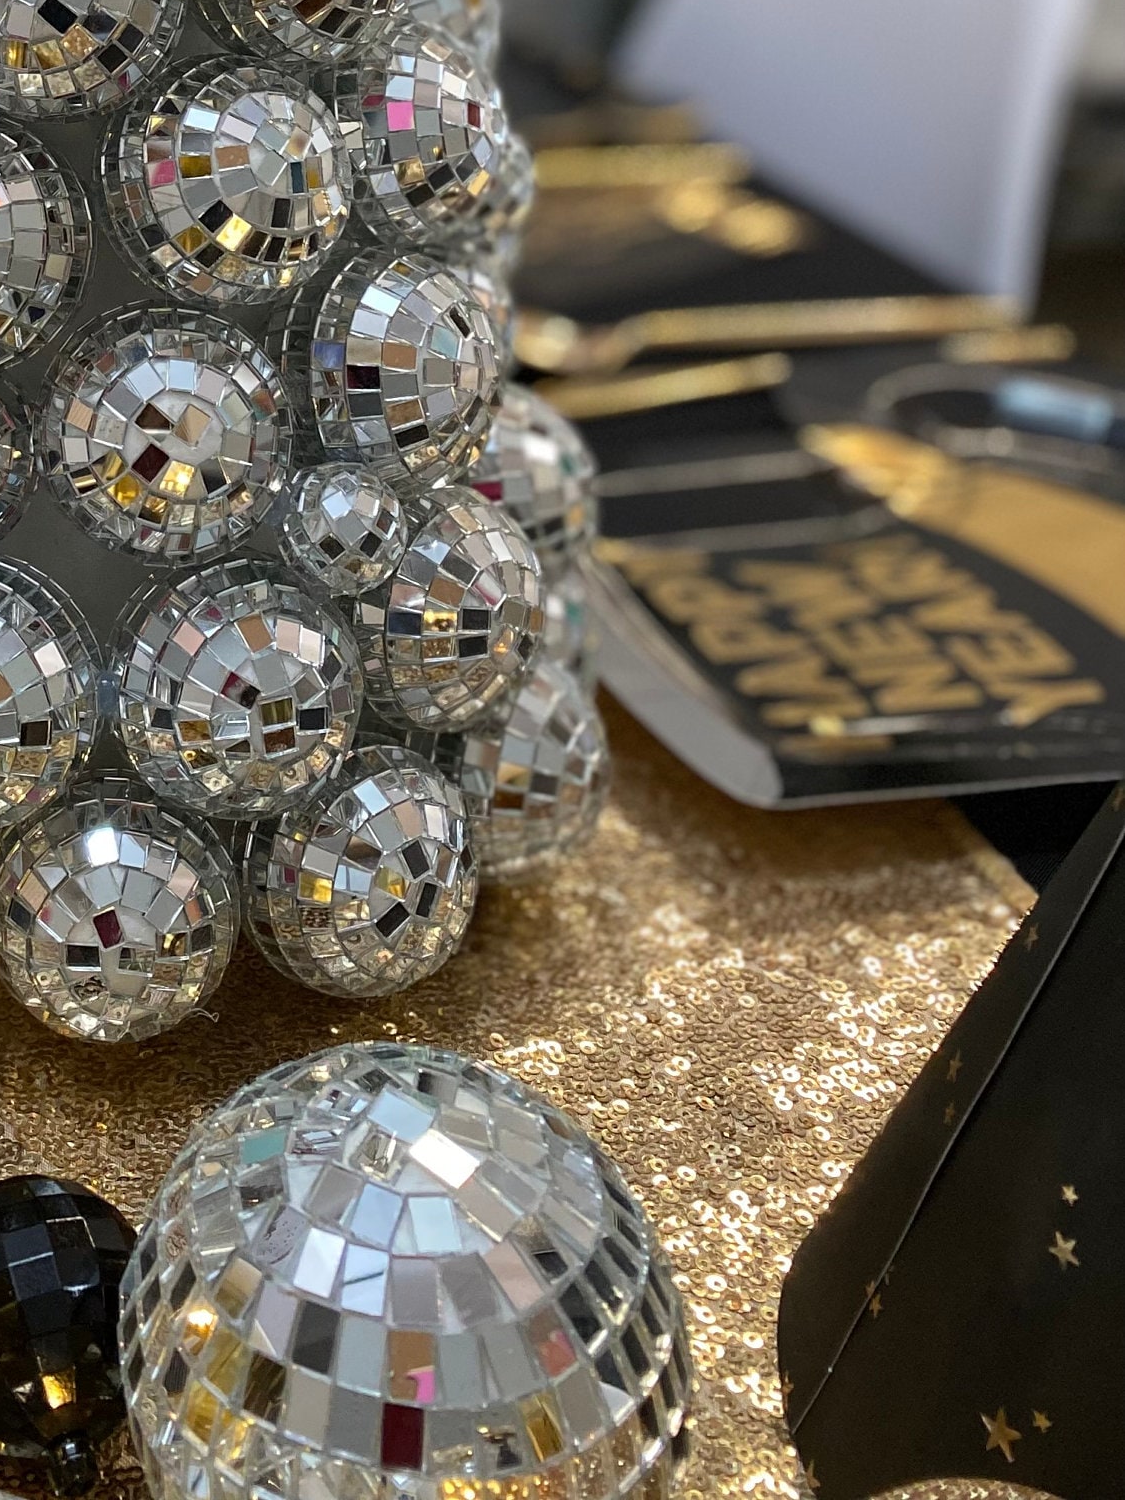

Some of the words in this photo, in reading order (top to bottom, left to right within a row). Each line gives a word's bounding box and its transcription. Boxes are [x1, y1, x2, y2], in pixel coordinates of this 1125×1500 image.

[592, 538, 894, 752] HAPPY
[733, 559, 985, 714] NEW
[819, 534, 1105, 728] YEAR
